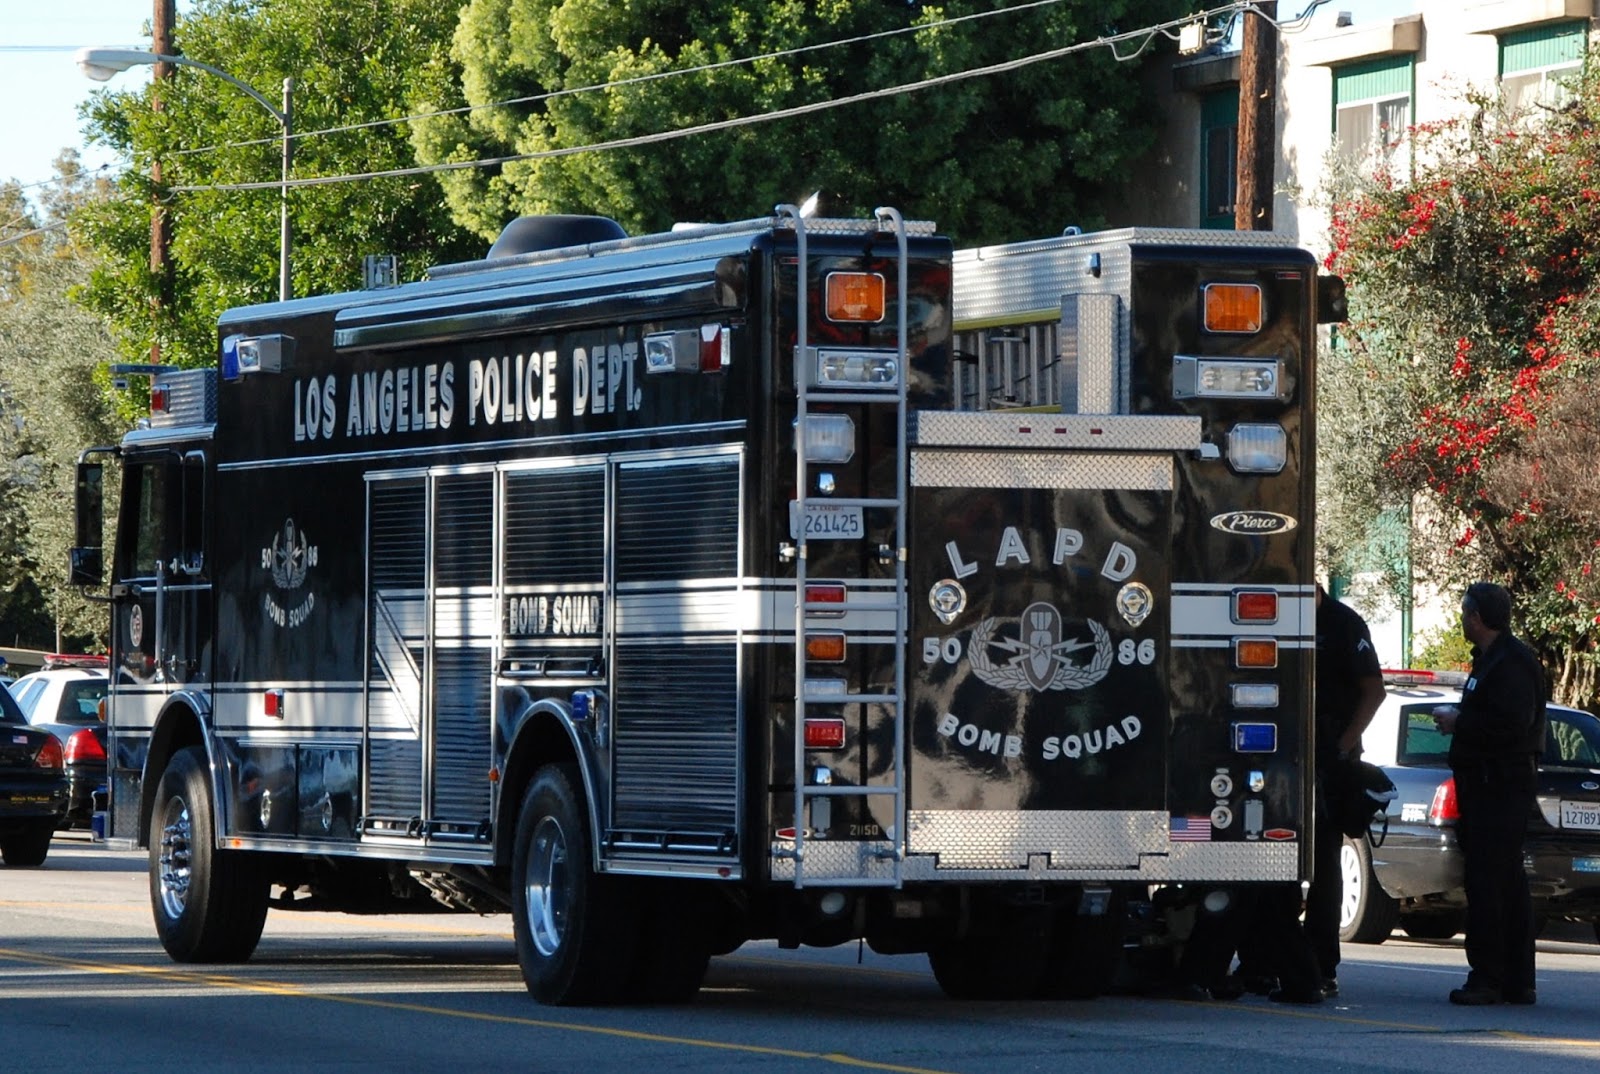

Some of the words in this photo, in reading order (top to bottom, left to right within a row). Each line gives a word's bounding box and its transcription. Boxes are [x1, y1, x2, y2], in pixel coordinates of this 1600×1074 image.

[294, 374, 336, 441] LOS
[346, 361, 454, 437] ANGELES
[469, 351, 557, 426] POLICE
[573, 342, 642, 416] DEPT.
[1229, 513, 1277, 530] Pierce
[261, 547, 272, 569] 50
[264, 593, 286, 627] BOMB
[289, 592, 315, 628] SQUAD
[509, 596, 548, 634] BOMB
[552, 595, 600, 636] SQUAD
[923, 636, 961, 664] 50
[1118, 638, 1156, 665] 86
[937, 712, 1023, 758] BOMB
[1042, 715, 1142, 761] SQUAD
